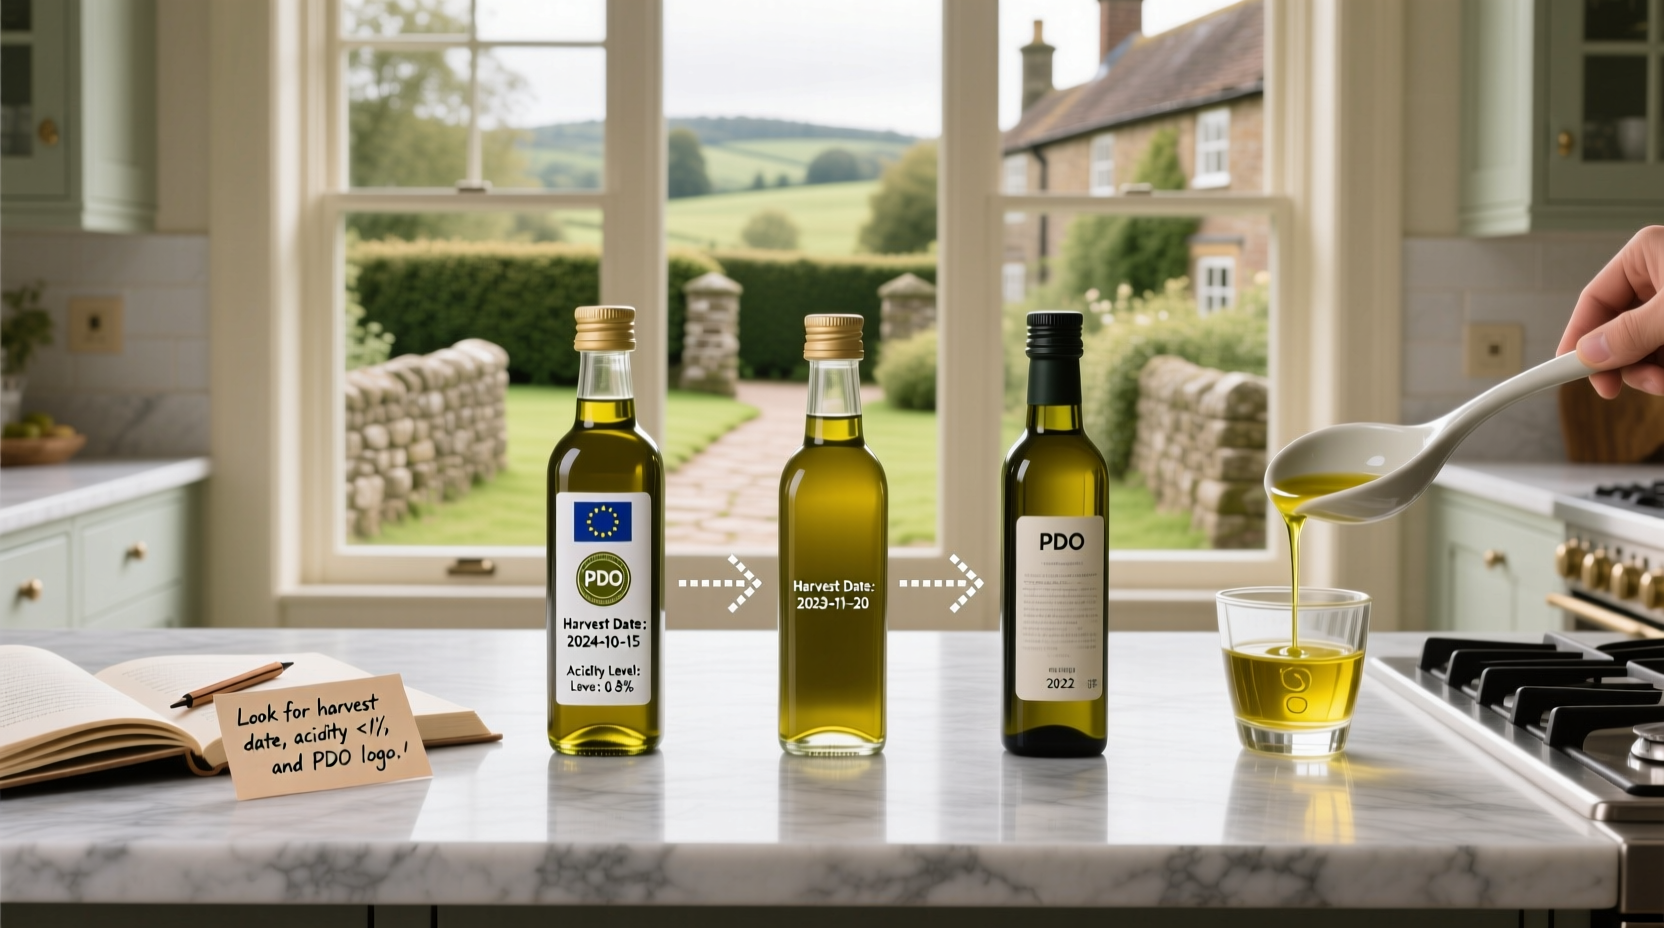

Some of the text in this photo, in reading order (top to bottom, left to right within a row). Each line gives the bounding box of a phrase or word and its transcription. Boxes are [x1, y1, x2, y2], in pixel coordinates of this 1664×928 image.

[1039, 532, 1085, 551] PDO
[584, 569, 623, 587] PDO
[793, 580, 875, 592] Harvest Date:
[563, 618, 647, 630] Harvest Date:
[567, 635, 640, 648] 2024-10-15
[608, 664, 641, 677] Level:
[1046, 677, 1075, 689] 2022
[237, 703, 279, 726] Look
[283, 701, 310, 722] for
[317, 693, 379, 716] harvest
[243, 732, 287, 751] date,
[272, 752, 303, 774] and
[313, 749, 351, 771] PDO
